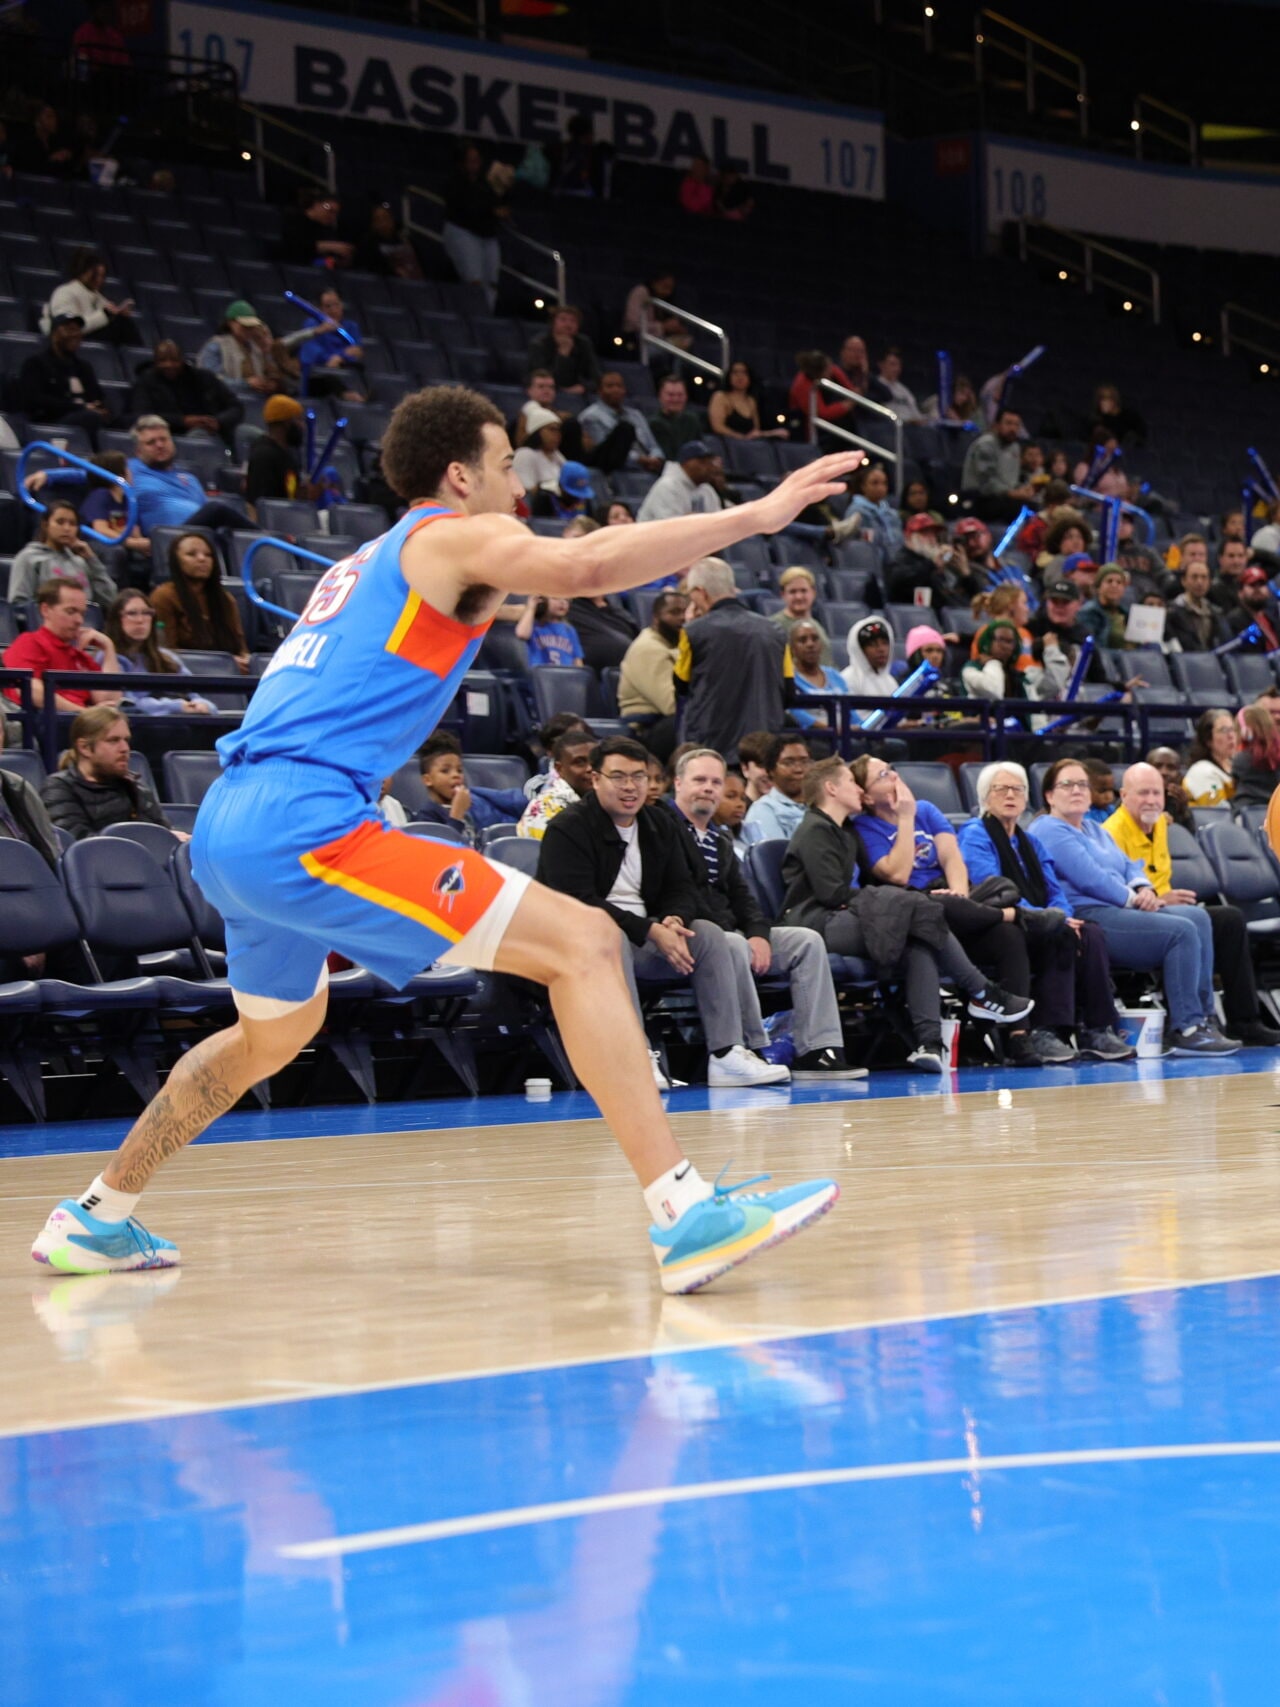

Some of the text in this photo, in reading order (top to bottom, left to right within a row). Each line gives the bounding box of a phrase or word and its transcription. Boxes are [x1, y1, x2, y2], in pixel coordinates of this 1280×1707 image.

[295, 46, 790, 181] BASKETBALL
[820, 138, 877, 192] 107
[994, 168, 1046, 218] 108
